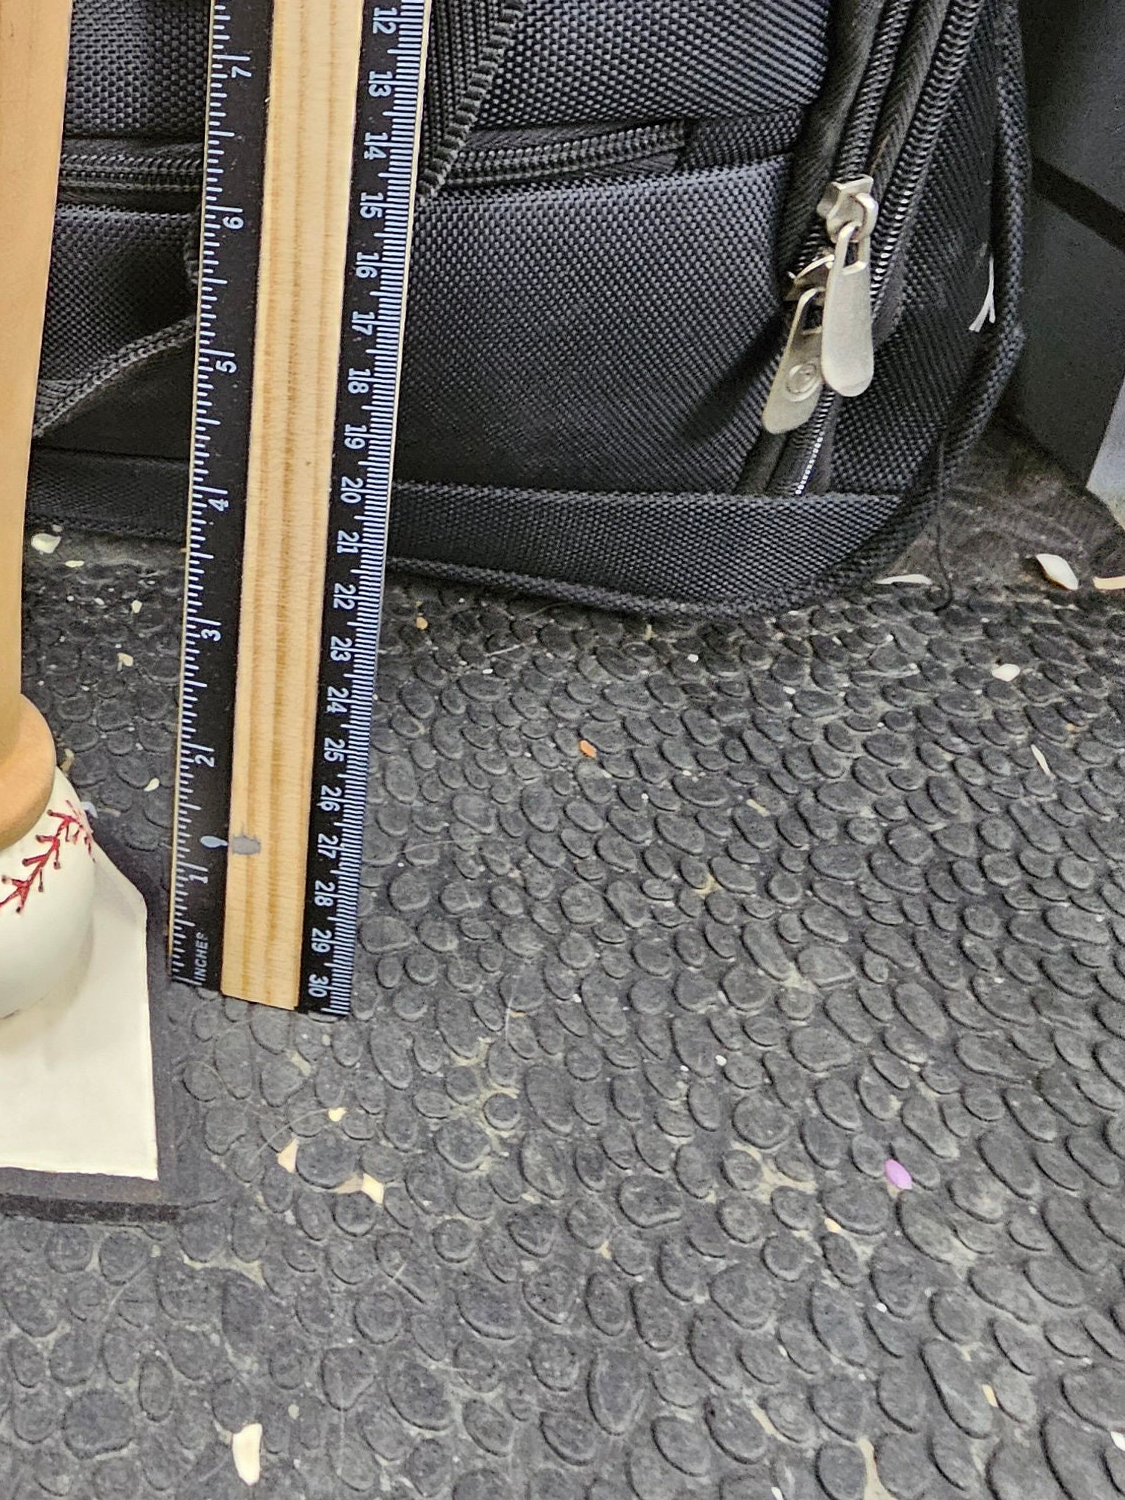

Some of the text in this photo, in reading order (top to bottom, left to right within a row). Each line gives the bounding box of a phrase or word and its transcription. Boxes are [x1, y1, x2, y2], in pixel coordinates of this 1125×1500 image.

[372, 7, 398, 35] 12
[231, 66, 252, 79] 7
[368, 70, 393, 98] 13
[363, 132, 389, 161] 14
[359, 192, 384, 219] 15
[222, 216, 244, 230] 6
[355, 251, 380, 280] 16
[351, 311, 375, 336] 17
[215, 360, 237, 374] 5
[347, 367, 370, 394] 18
[343, 424, 368, 449] 19
[340, 476, 364, 504] 20
[208, 498, 229, 512] 4
[336, 530, 360, 554] 21
[333, 582, 357, 611] 22
[200, 629, 222, 642] 3
[330, 636, 353, 662] 23
[326, 686, 349, 714] 24
[194, 754, 215, 768] 2
[323, 737, 346, 763] 25
[320, 785, 342, 812] 26
[317, 833, 339, 860] 27
[188, 873, 209, 884] 1
[314, 880, 335, 908] 28
[311, 927, 333, 954] 29
[308, 974, 330, 998] 30
